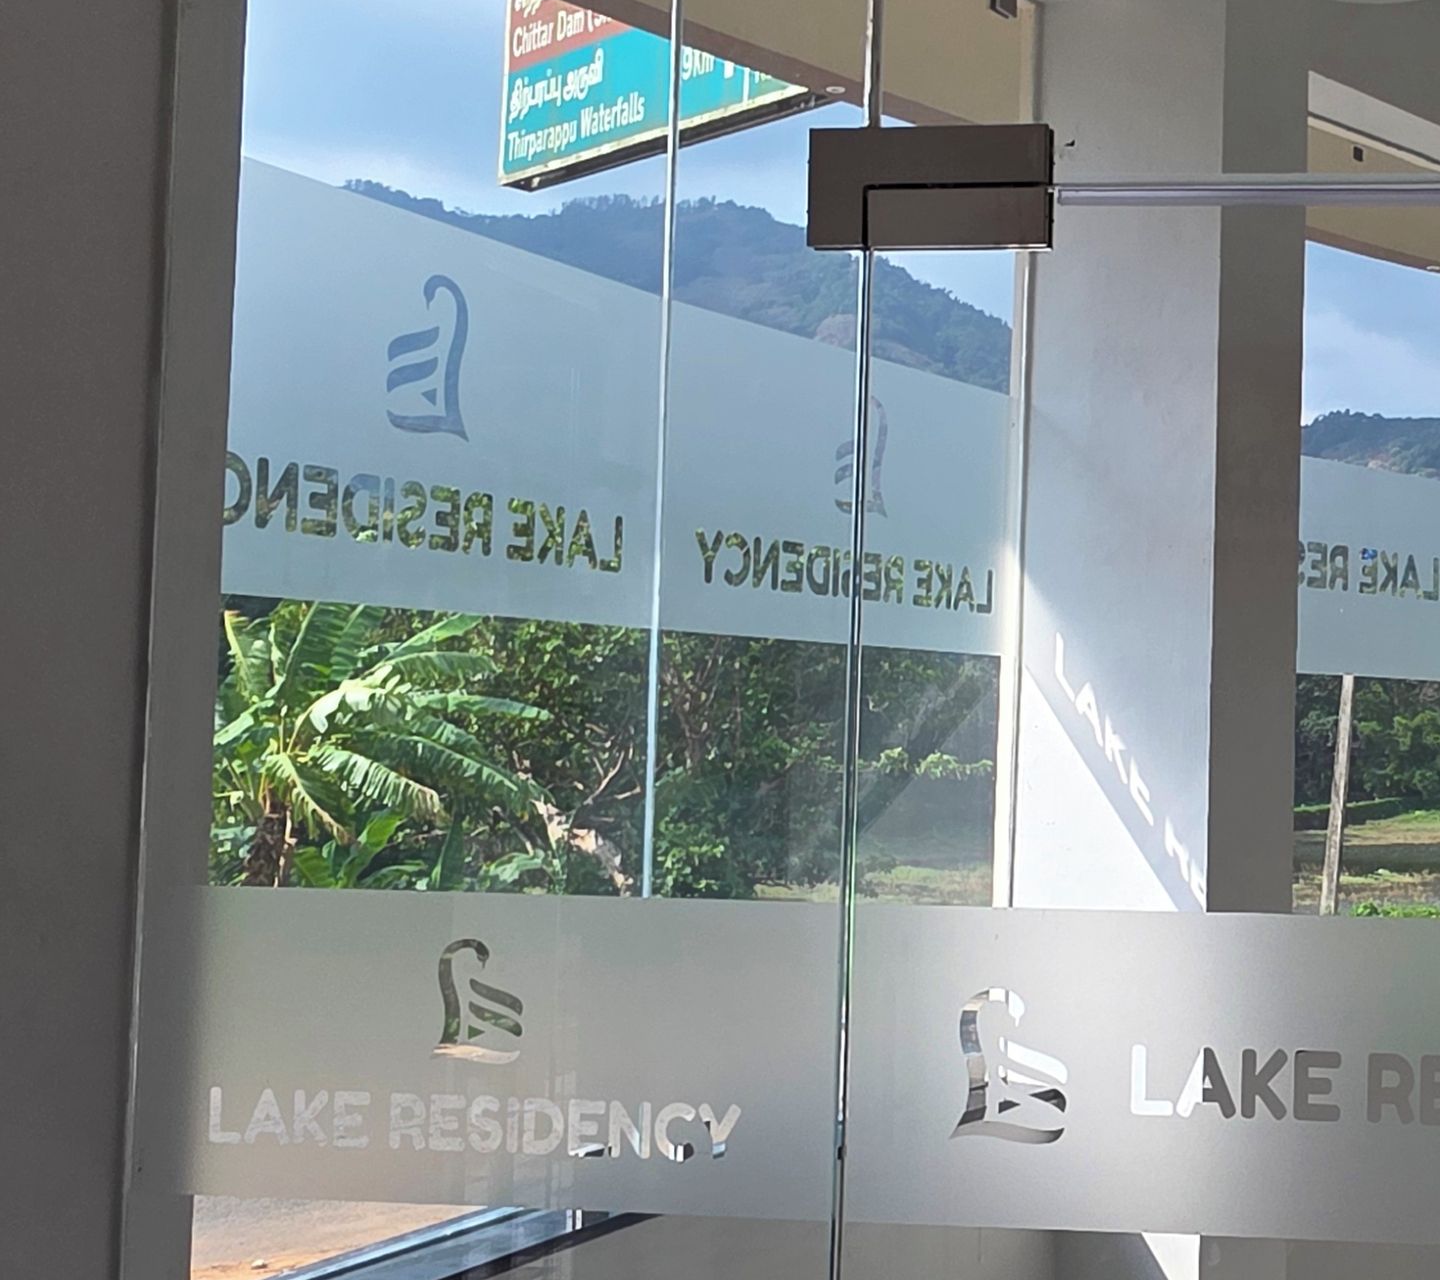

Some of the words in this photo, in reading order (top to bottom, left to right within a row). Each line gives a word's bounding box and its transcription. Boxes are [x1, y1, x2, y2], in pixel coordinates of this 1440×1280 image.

[513, 19, 554, 57] Chittar
[557, 10, 584, 41] Dam
[508, 120, 578, 162] Thirparappu
[580, 91, 646, 139] Waterfalls
[1130, 1043, 1343, 1122] LAKE
[208, 1086, 371, 1149] LAKE
[389, 1091, 742, 1163] RESIDENCY
